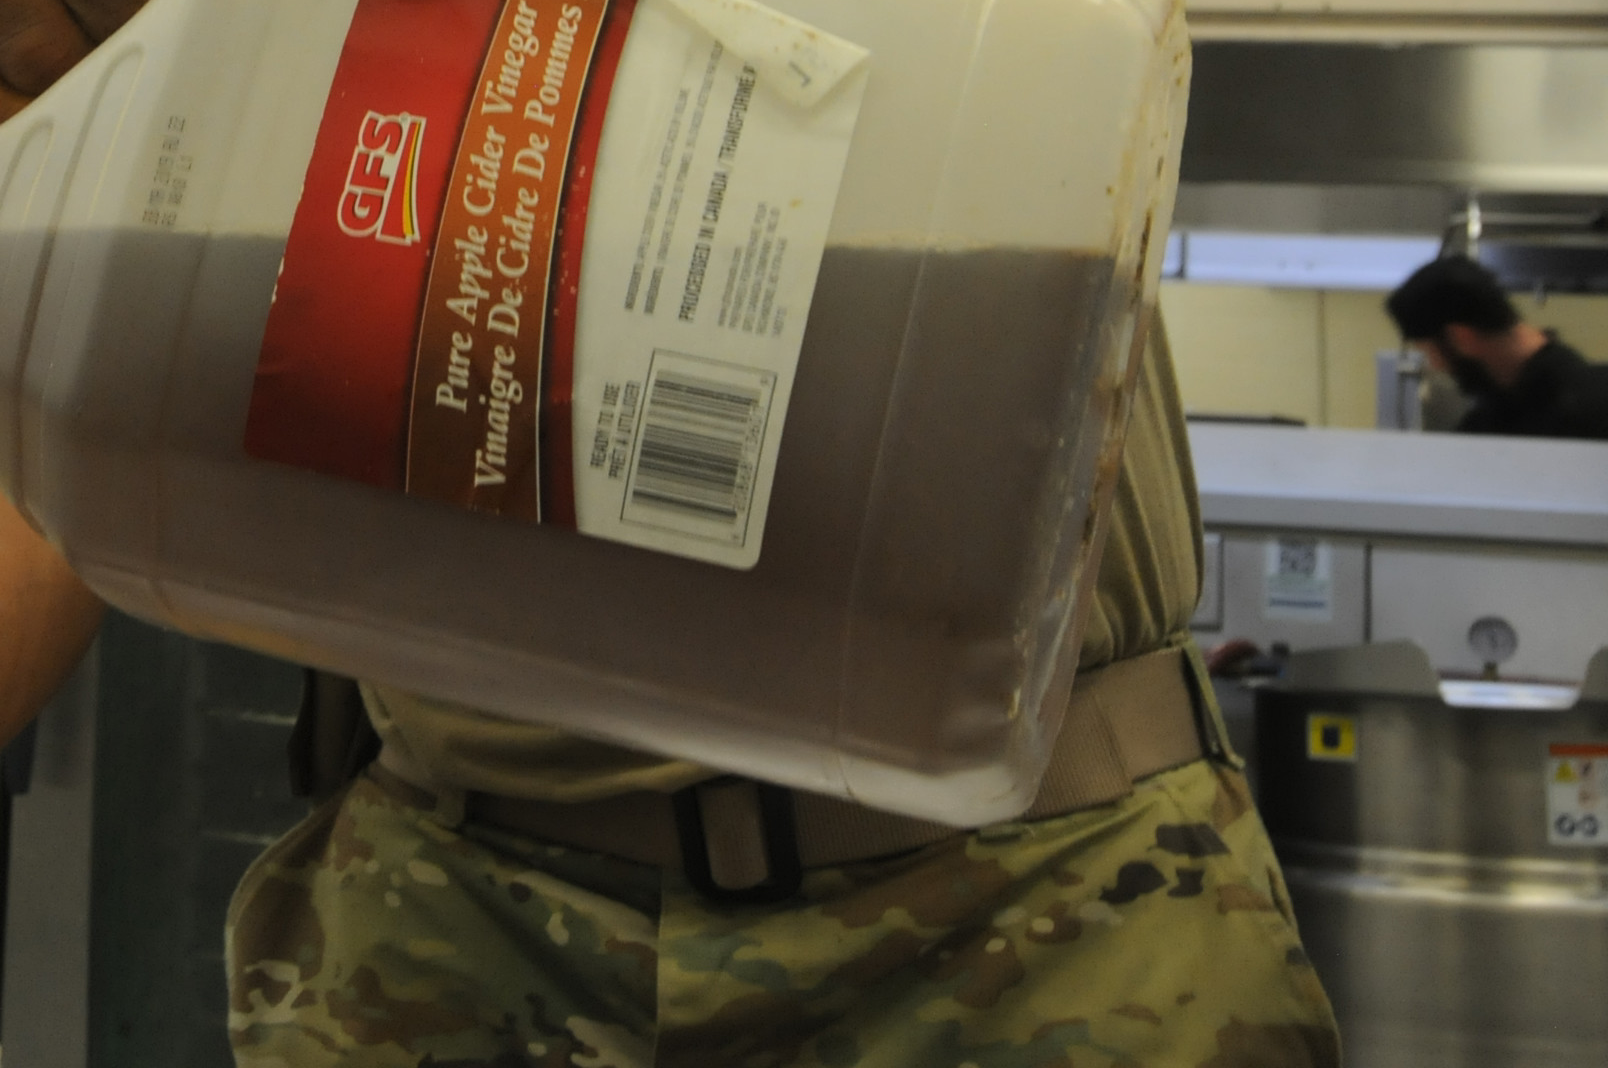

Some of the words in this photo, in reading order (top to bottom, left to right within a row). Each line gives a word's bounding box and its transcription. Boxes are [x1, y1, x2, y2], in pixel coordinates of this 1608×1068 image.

[481, 0, 539, 115] Vinegar
[524, 4, 582, 127] Pommes
[337, 110, 406, 238] GFS
[463, 125, 506, 216] Cider
[512, 133, 549, 181] De
[702, 172, 728, 223] CANADA
[446, 225, 493, 326] Apple
[496, 187, 539, 278] Cidre
[487, 287, 523, 337] De
[436, 331, 473, 413] Pure
[474, 345, 523, 487] Vinaigre
